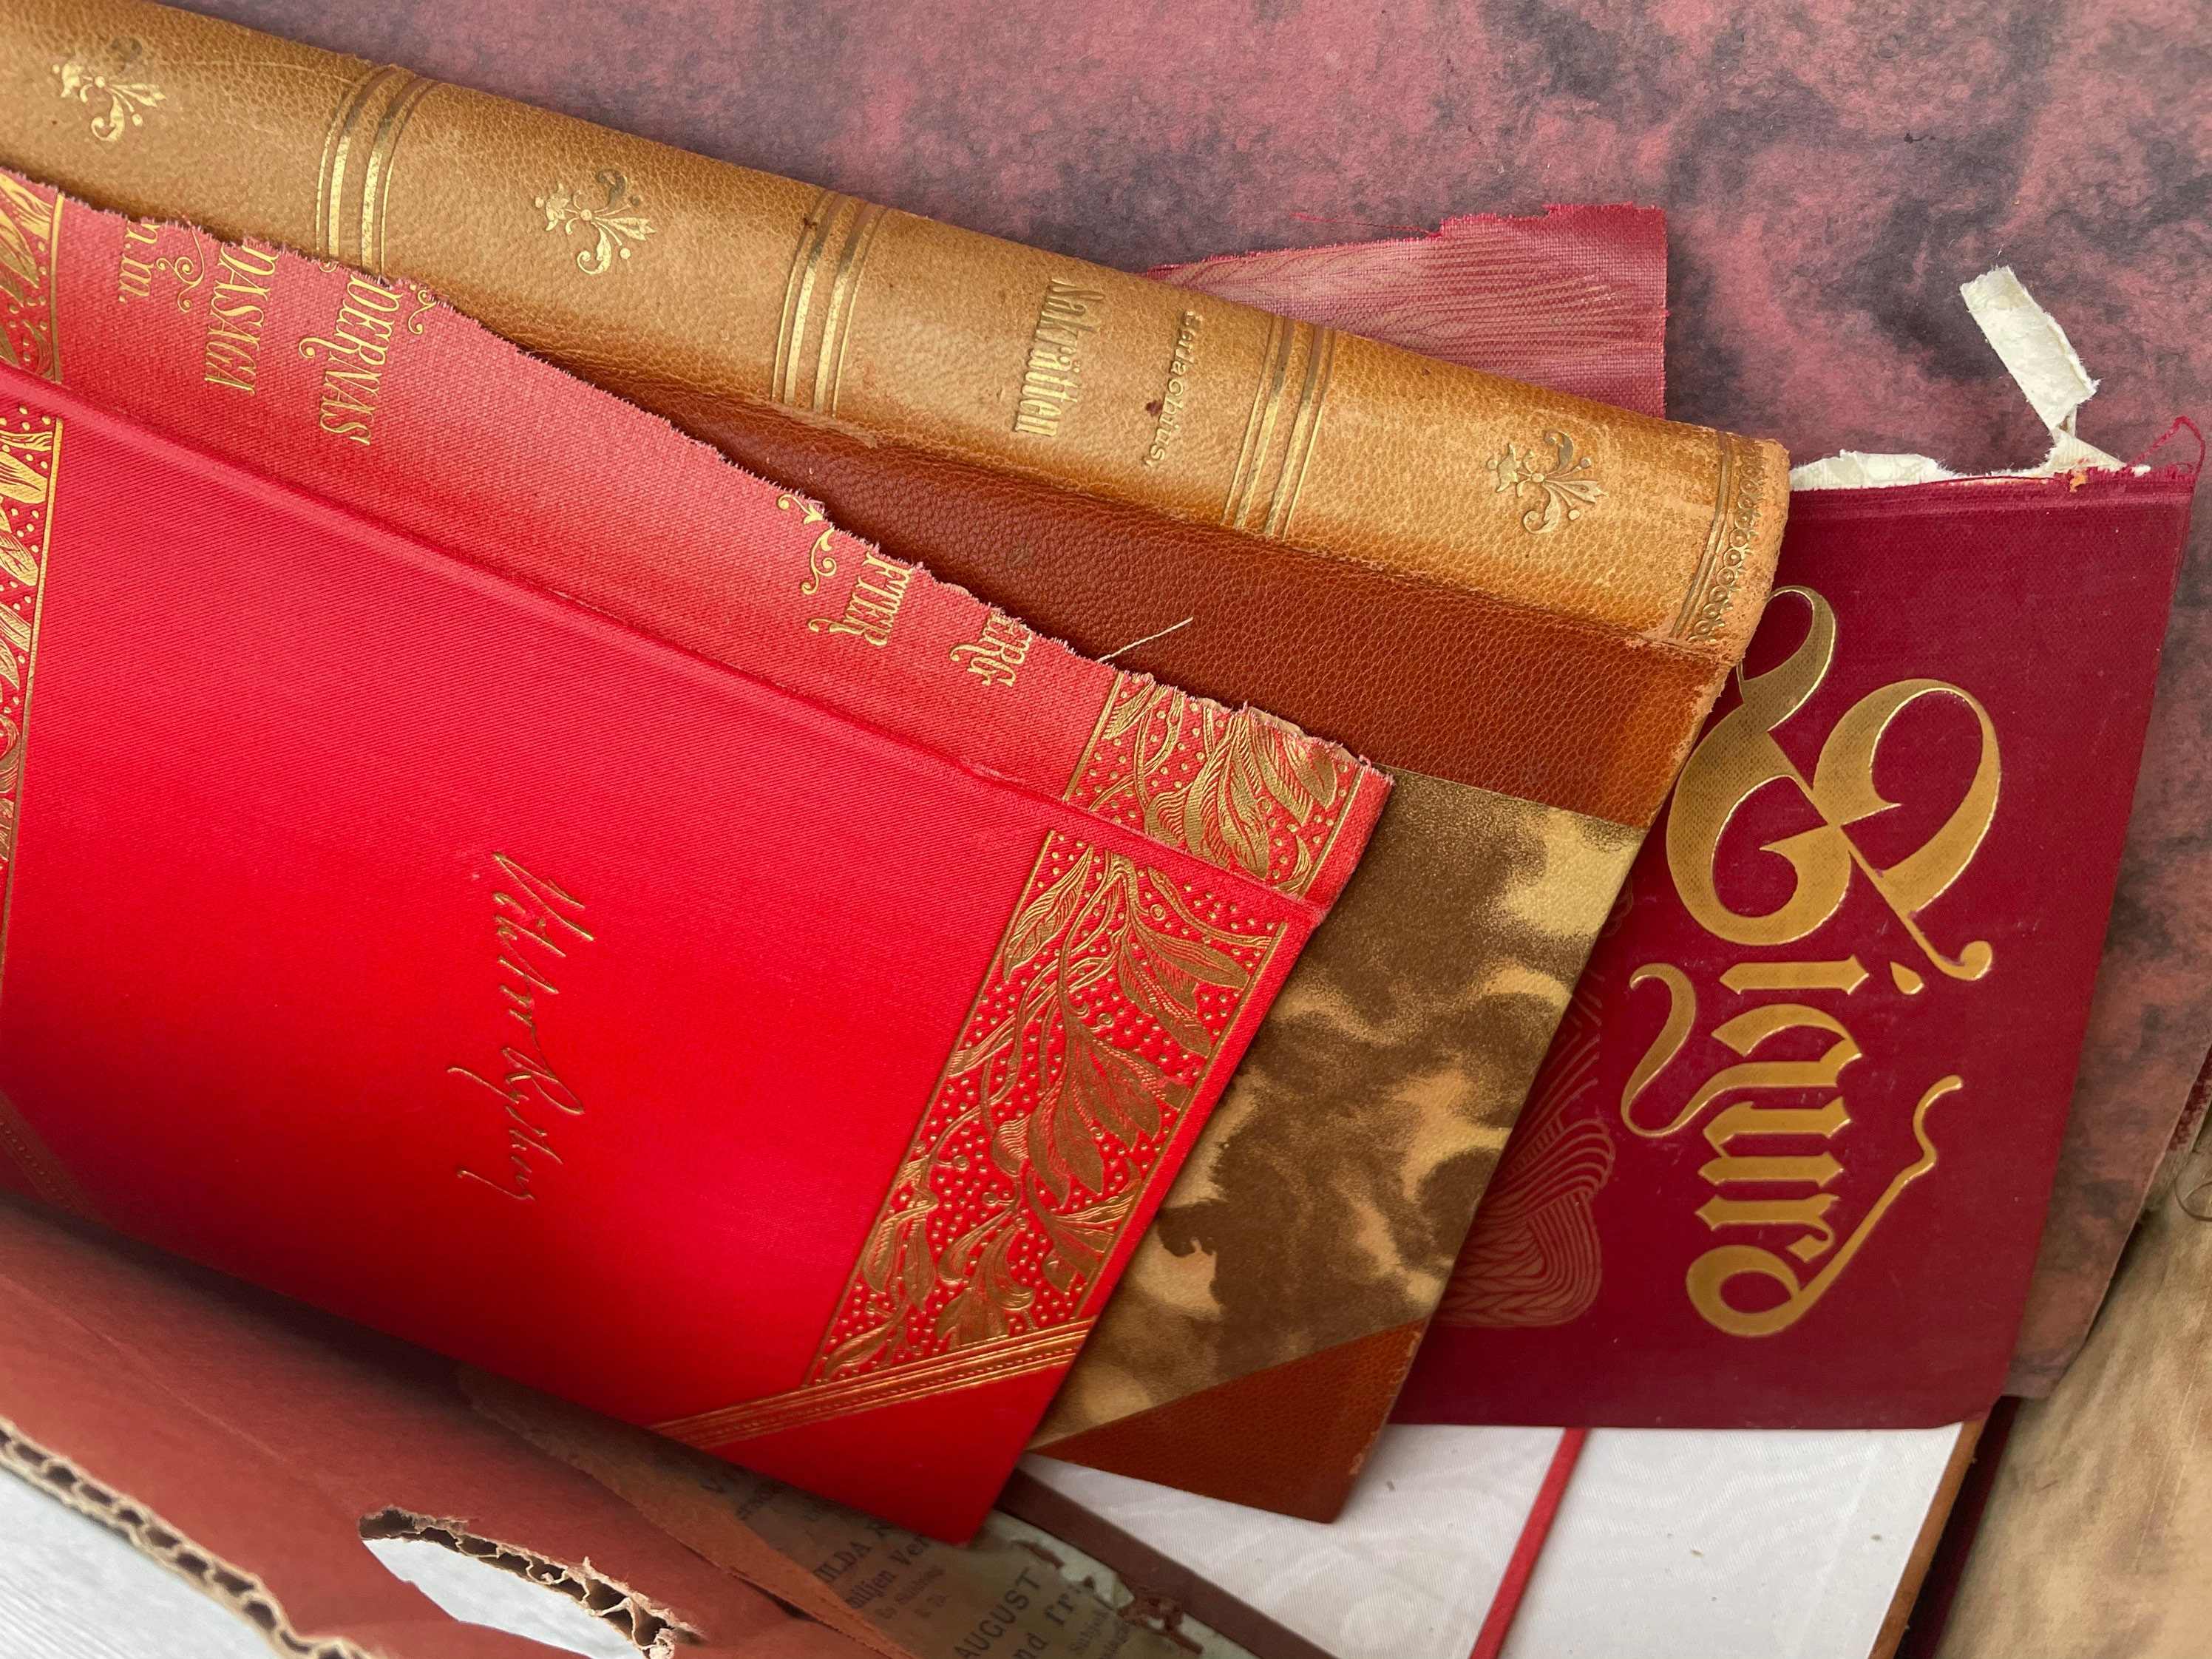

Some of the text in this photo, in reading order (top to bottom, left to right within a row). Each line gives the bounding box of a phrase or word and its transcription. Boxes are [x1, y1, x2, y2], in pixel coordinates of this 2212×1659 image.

[299, 274, 404, 445] DERNAS
[808, 552, 915, 646] FTER
[949, 611, 1033, 687] ERG
[1620, 586, 2001, 1337] Sigurd
[954, 1567, 1041, 1659] AUGUST
